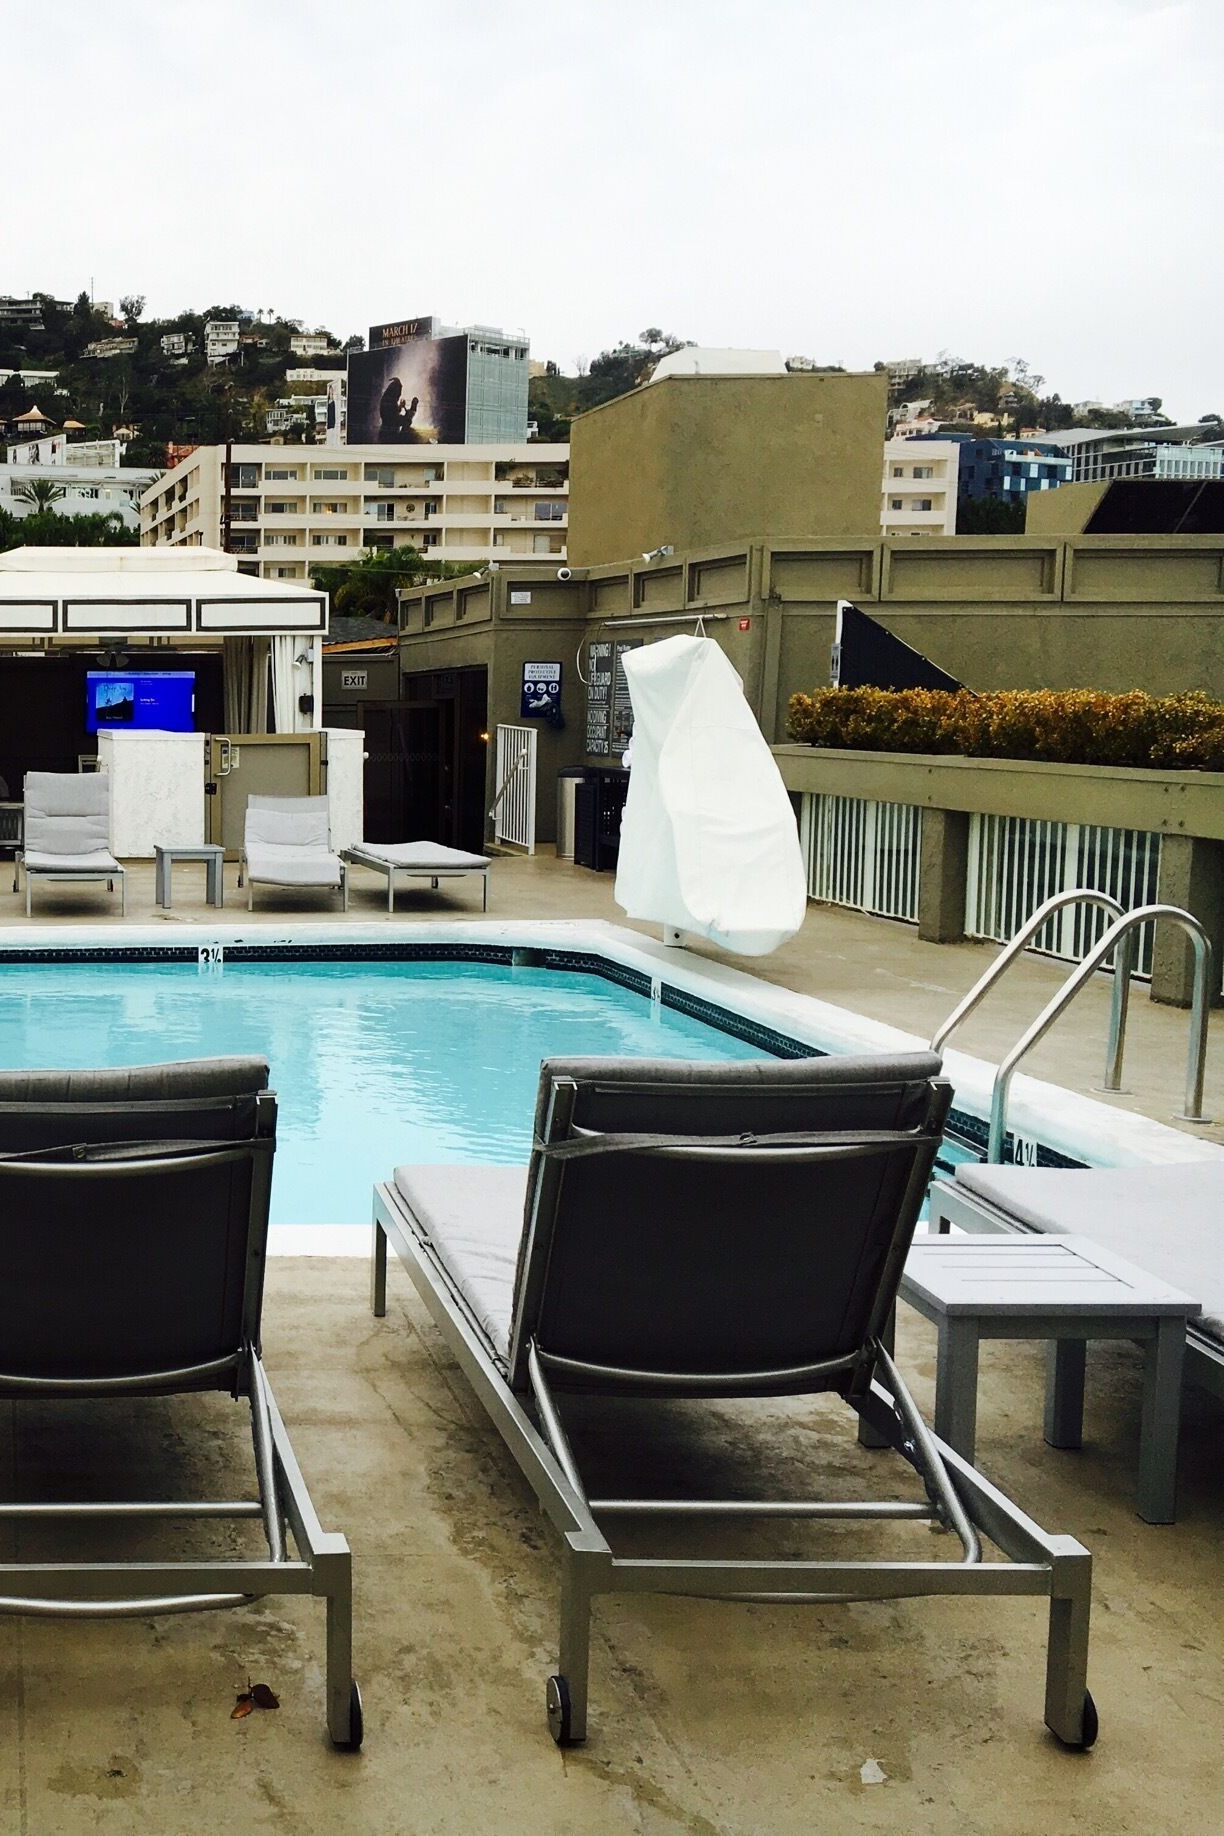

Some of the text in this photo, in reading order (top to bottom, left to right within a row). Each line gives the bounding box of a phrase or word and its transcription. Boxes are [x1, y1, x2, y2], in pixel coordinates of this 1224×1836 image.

[382, 322, 418, 337] MARCH 17
[343, 675, 366, 686] EXIT
